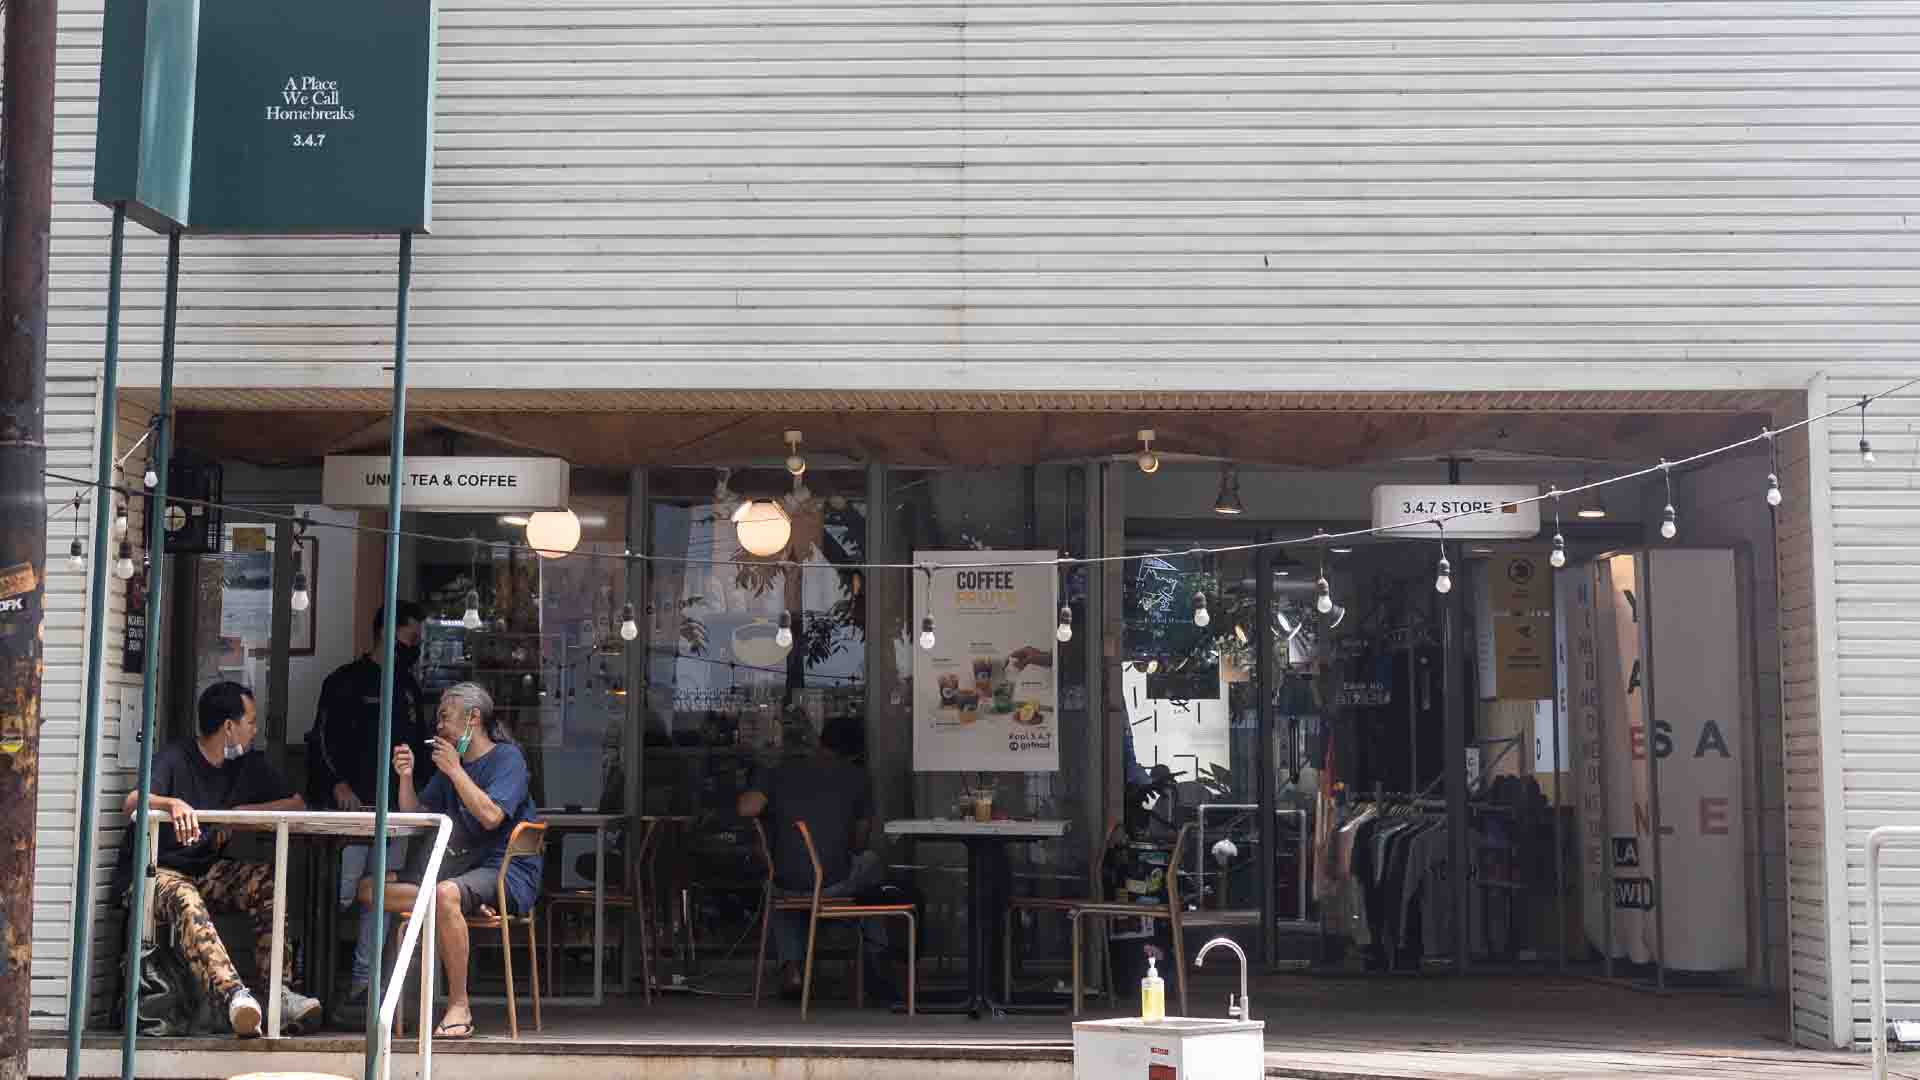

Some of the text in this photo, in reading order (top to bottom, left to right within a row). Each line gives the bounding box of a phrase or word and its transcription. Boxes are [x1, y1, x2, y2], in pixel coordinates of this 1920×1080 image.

[285, 76, 336, 90] A Place
[281, 91, 338, 105] We Call
[266, 106, 354, 120] Homebreaks
[293, 134, 325, 146] 3.4.7
[410, 474, 439, 486] TEA
[443, 474, 453, 486] &
[457, 475, 517, 487] COFFEE
[1403, 502, 1493, 513] 3.4.7 STORE
[956, 571, 1014, 589] COFFEE
